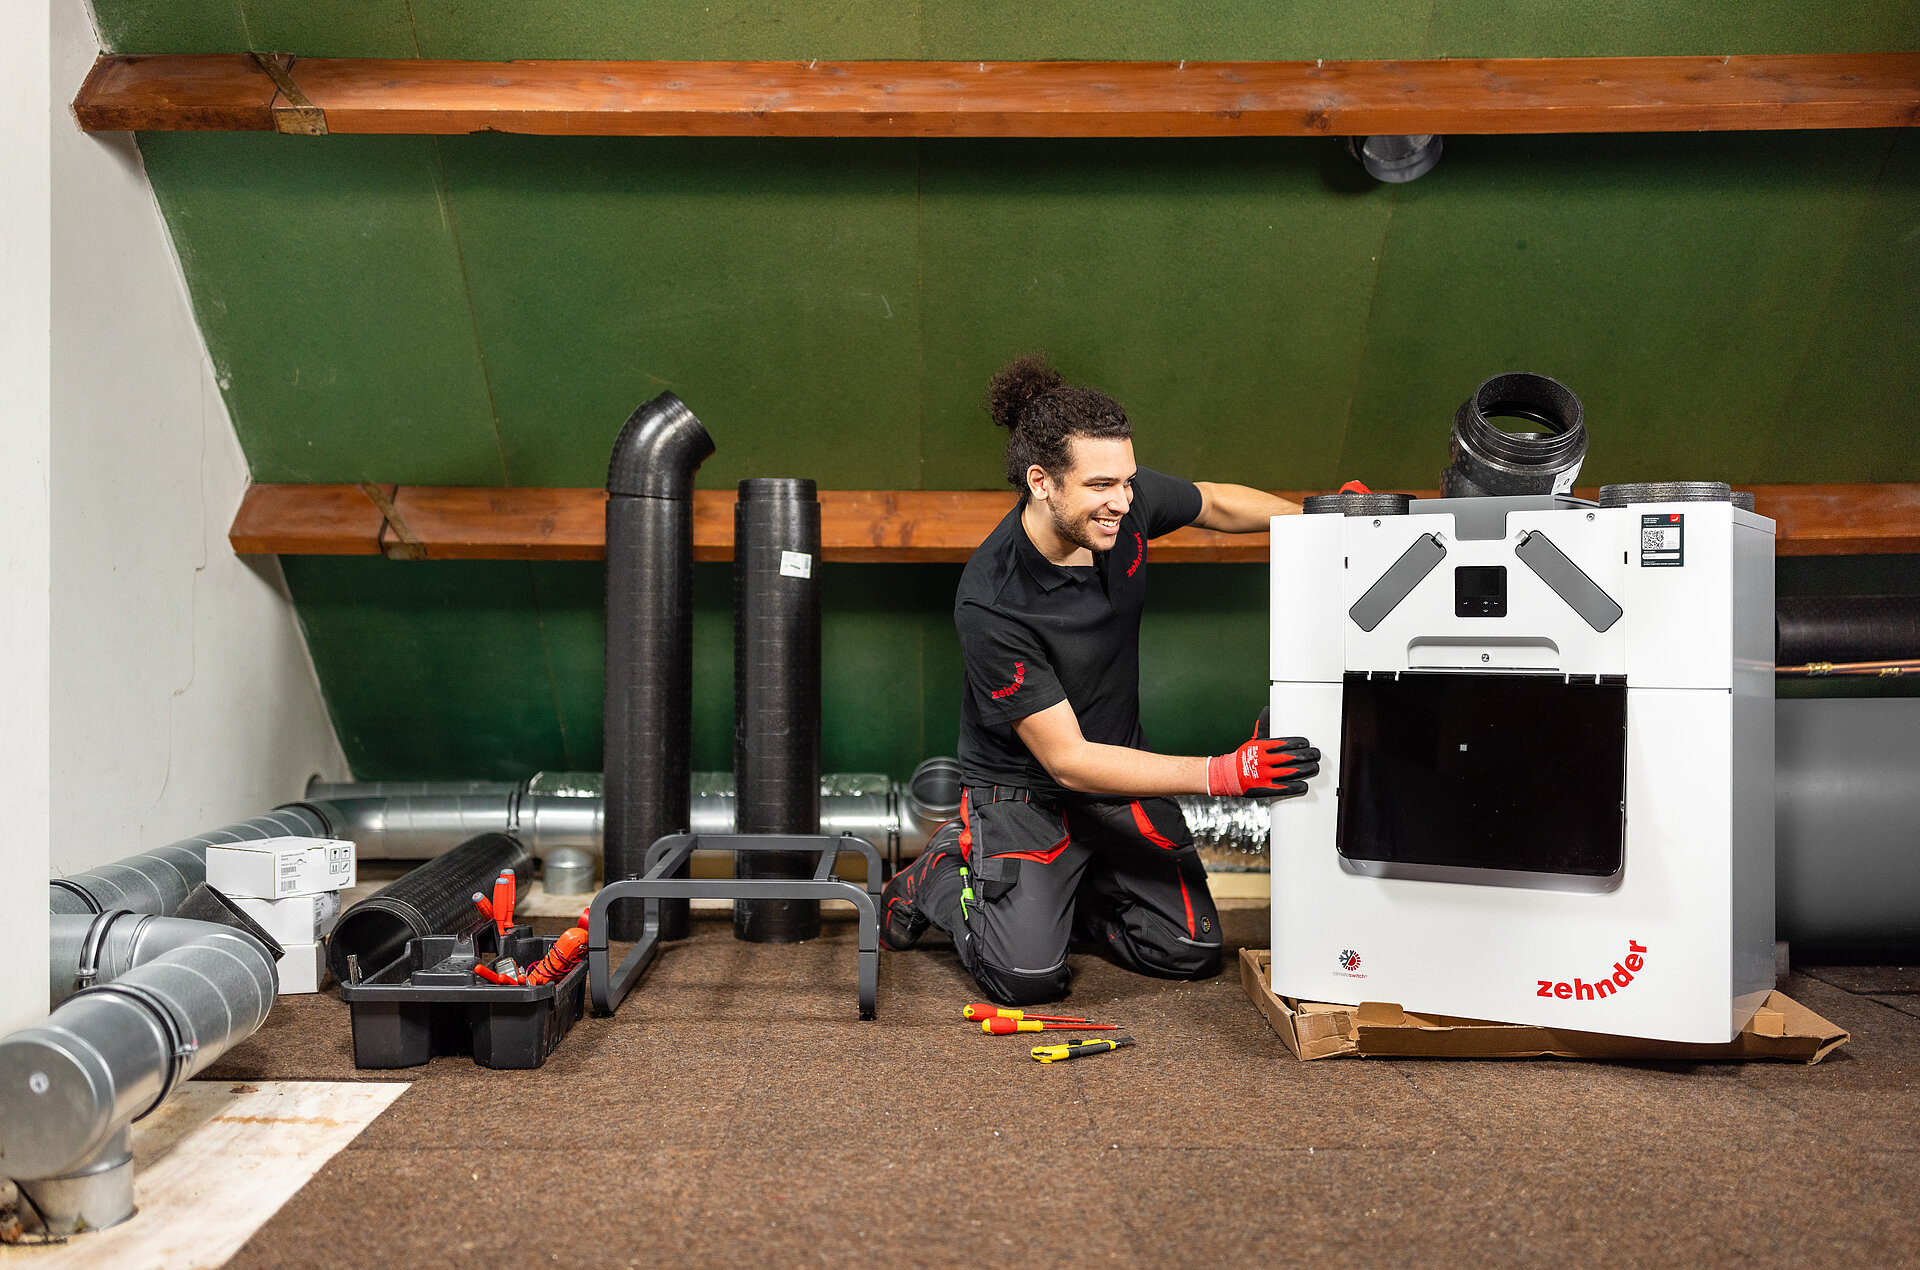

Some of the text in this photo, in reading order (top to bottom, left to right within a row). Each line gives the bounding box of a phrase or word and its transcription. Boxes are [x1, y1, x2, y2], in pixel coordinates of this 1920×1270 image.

[1126, 532, 1143, 578] zehnder
[991, 661, 1026, 700] zehnder
[1536, 939, 1648, 1001] zehnder
